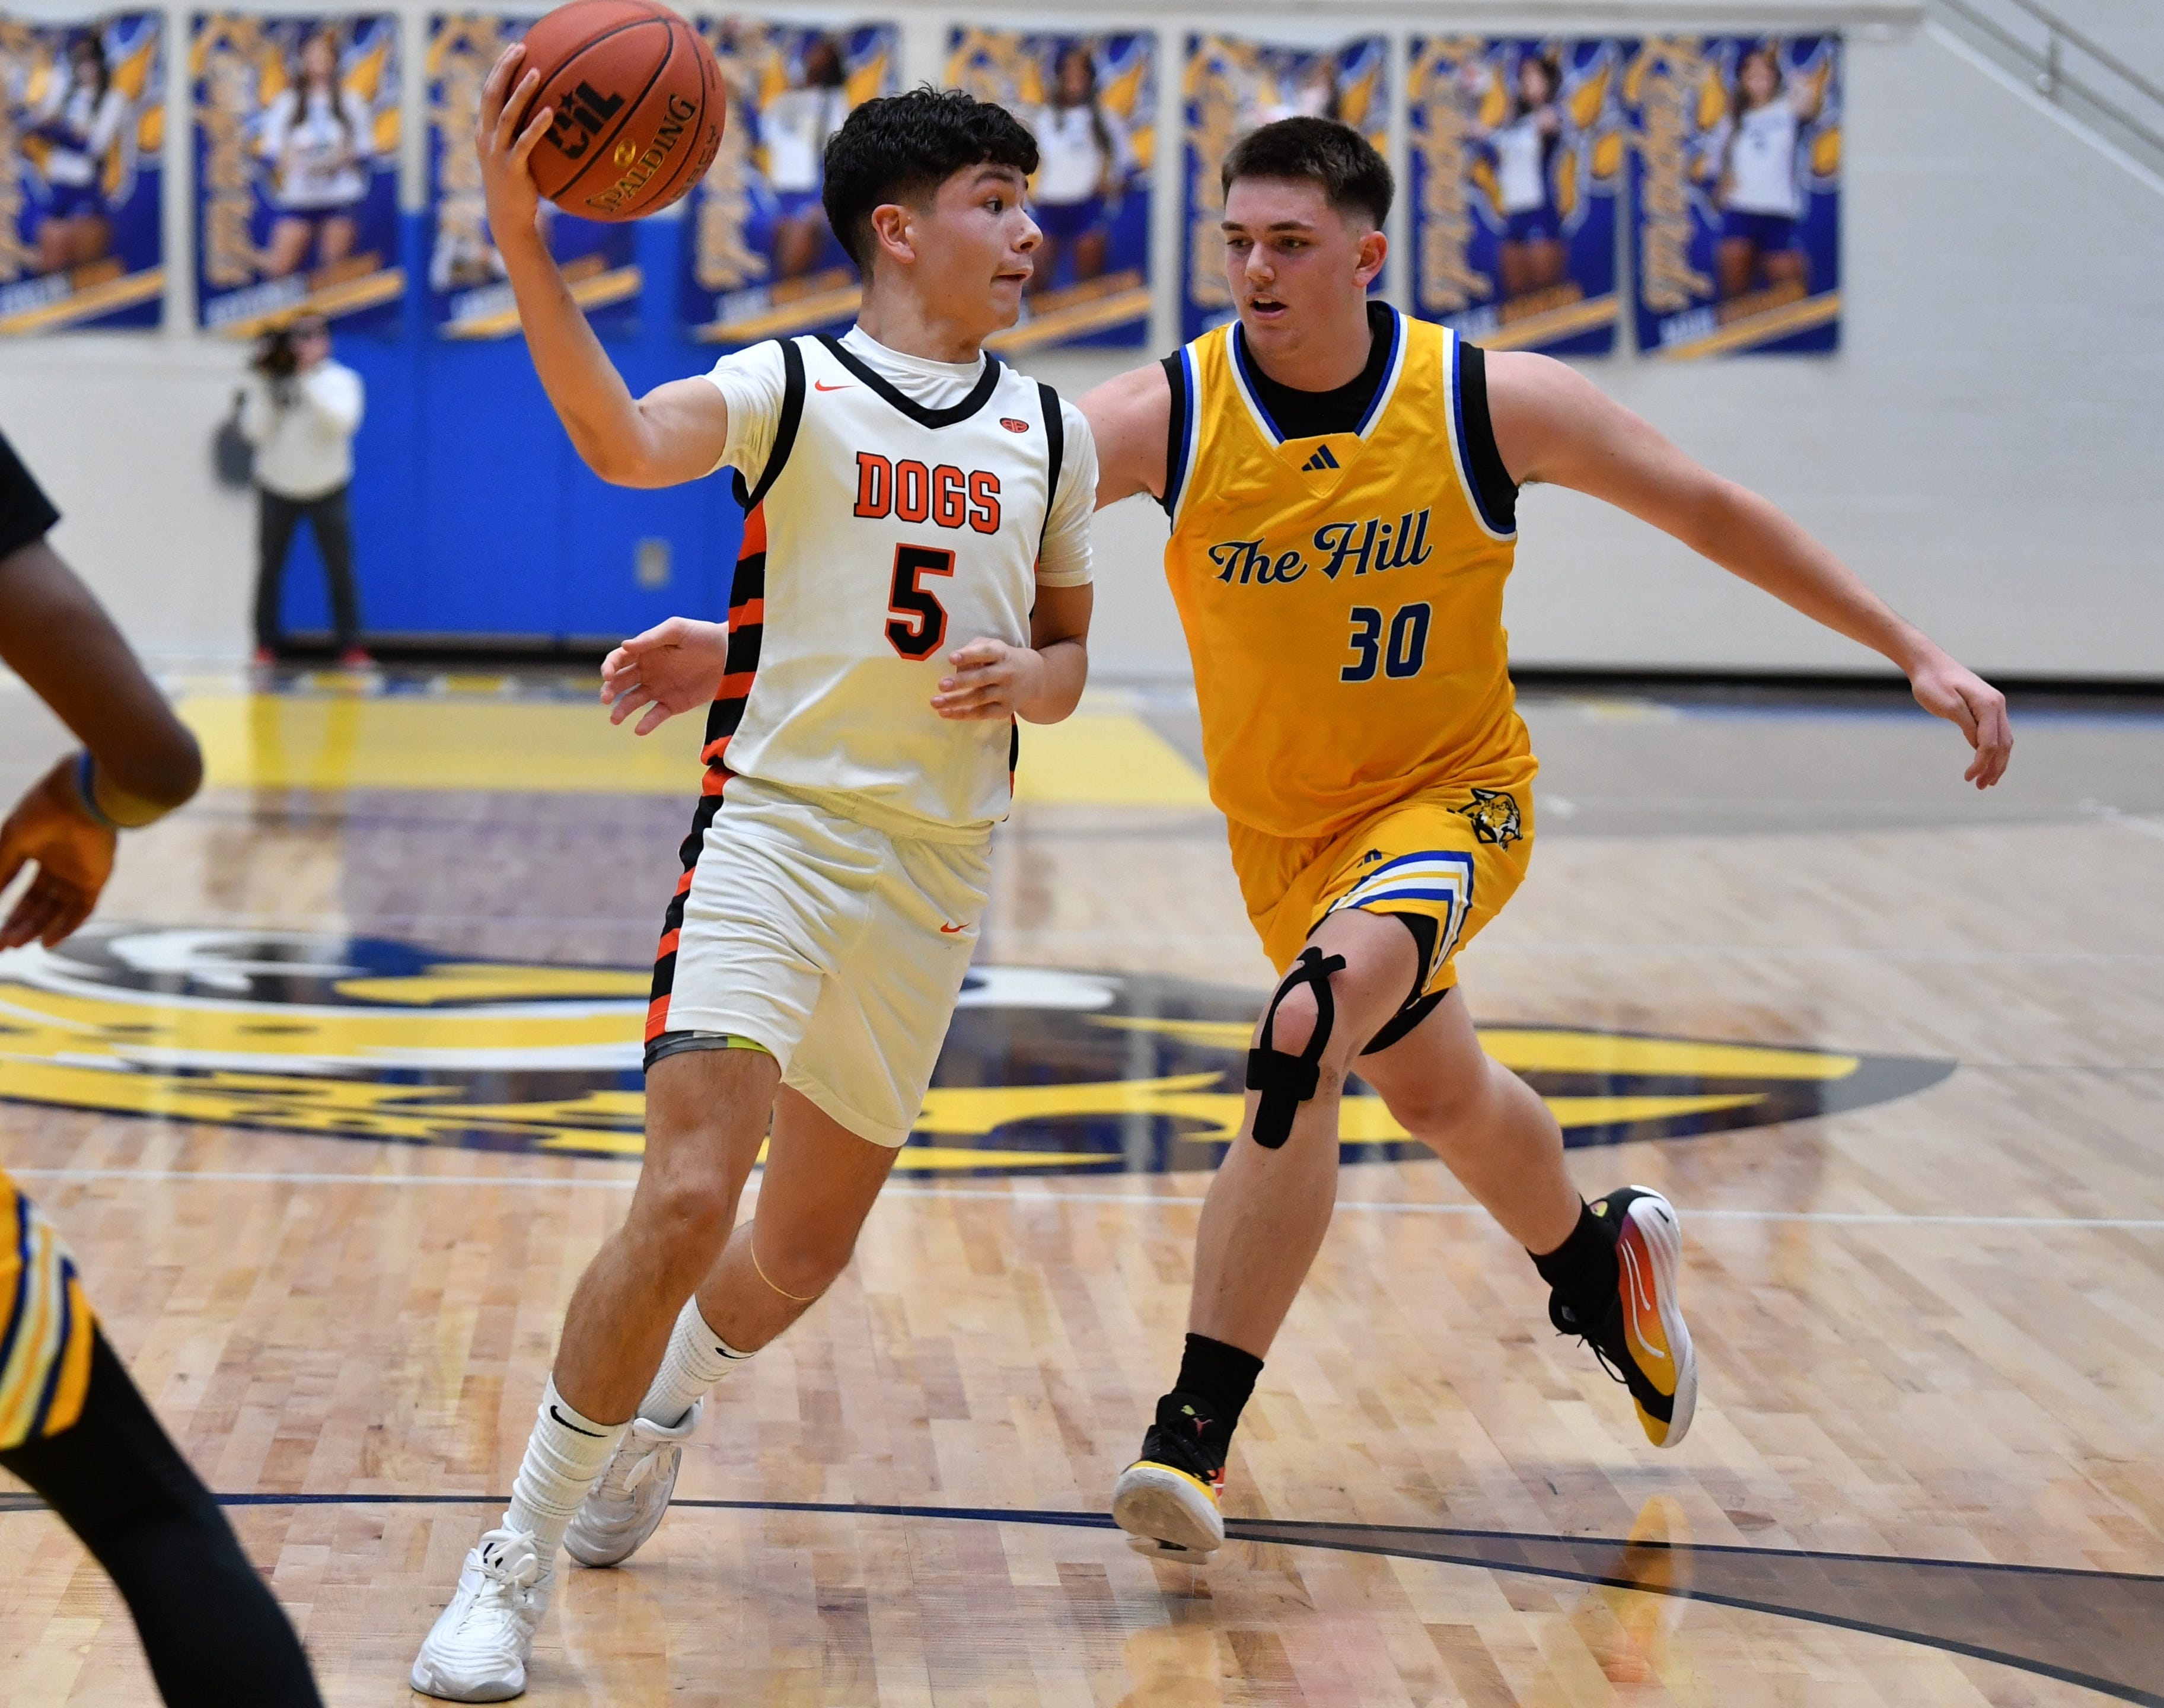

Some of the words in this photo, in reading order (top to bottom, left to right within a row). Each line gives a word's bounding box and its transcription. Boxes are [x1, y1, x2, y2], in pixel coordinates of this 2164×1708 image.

[584, 93, 697, 212] SPALDING
[853, 451, 1000, 535] DOGS
[1208, 536, 1309, 586] The
[1312, 505, 1434, 582] Hill
[884, 543, 955, 661] 5
[1338, 601, 1433, 683] 30
